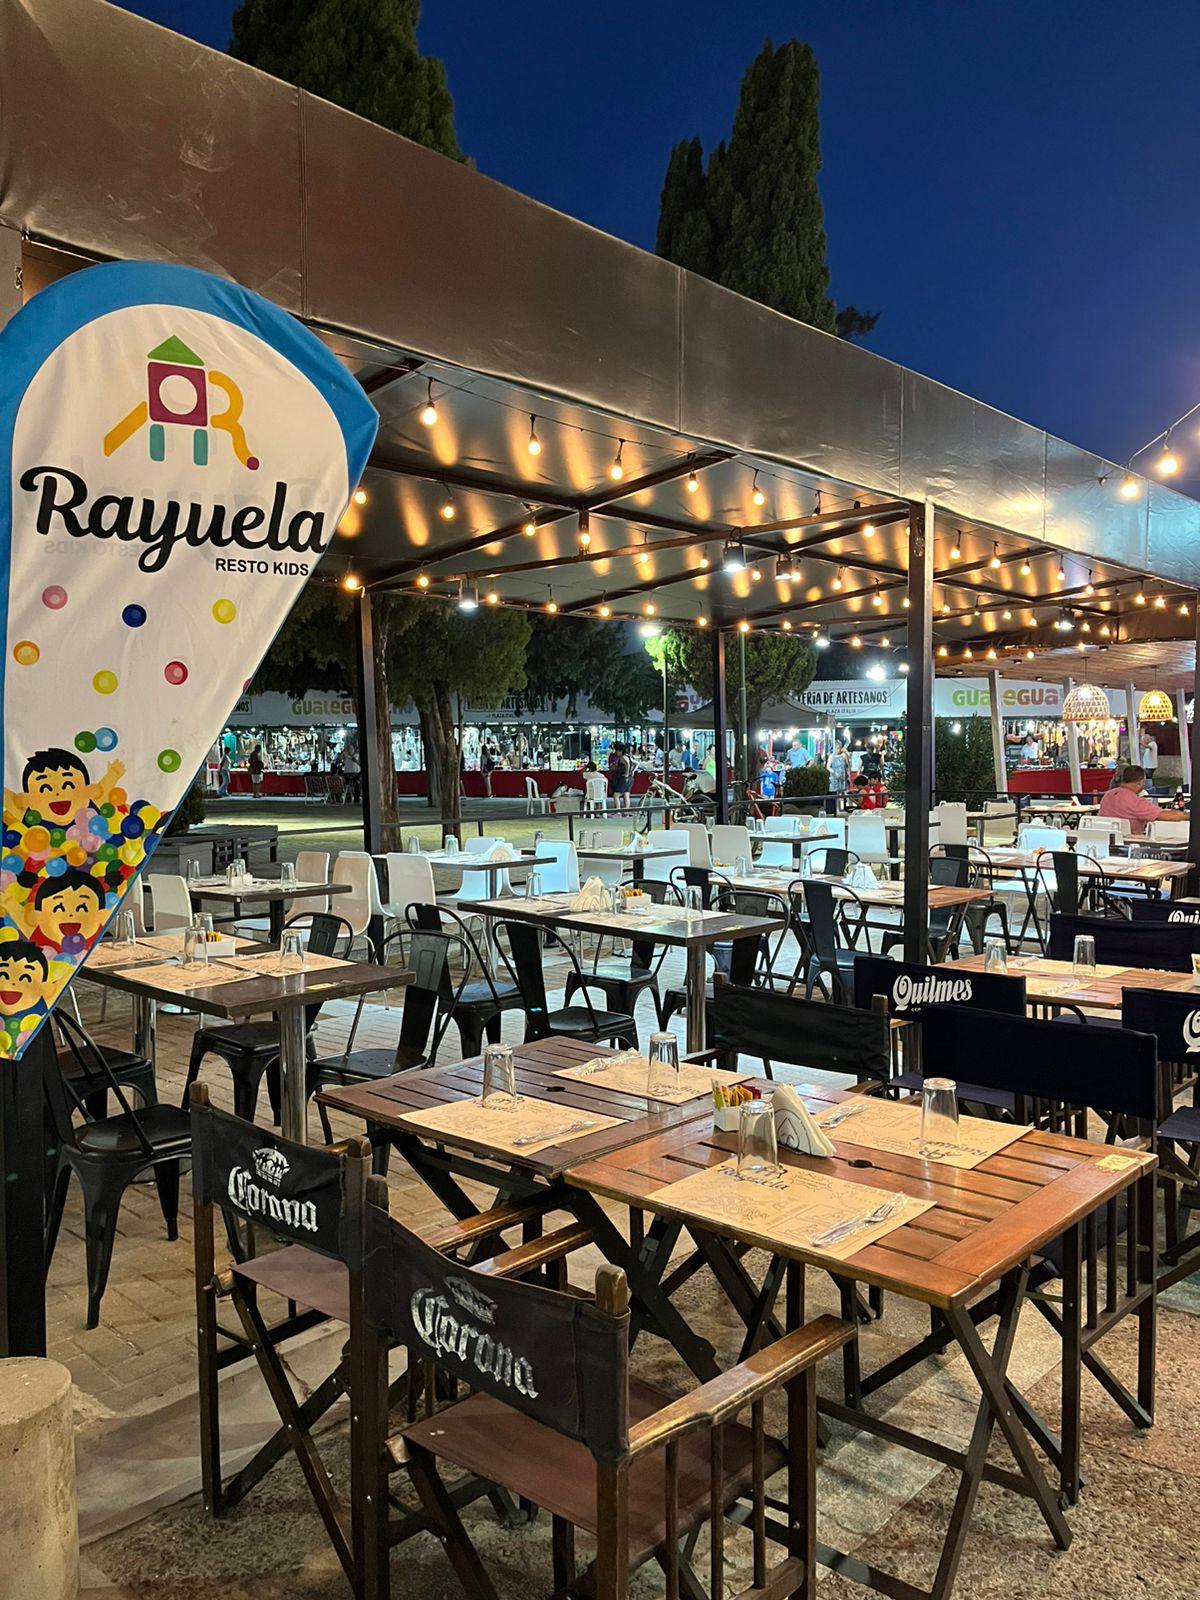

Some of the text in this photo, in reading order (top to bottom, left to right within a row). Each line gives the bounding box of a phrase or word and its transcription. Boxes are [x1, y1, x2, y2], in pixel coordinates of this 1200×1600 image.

[20, 466, 328, 573] Rayuela
[215, 558, 309, 576] RESTO KIDS
[824, 691, 834, 705] DE
[836, 690, 888, 705] ARTESANOS
[892, 974, 973, 1011] Quilmes
[228, 1165, 319, 1232] Corona
[410, 1287, 539, 1399] Corona
